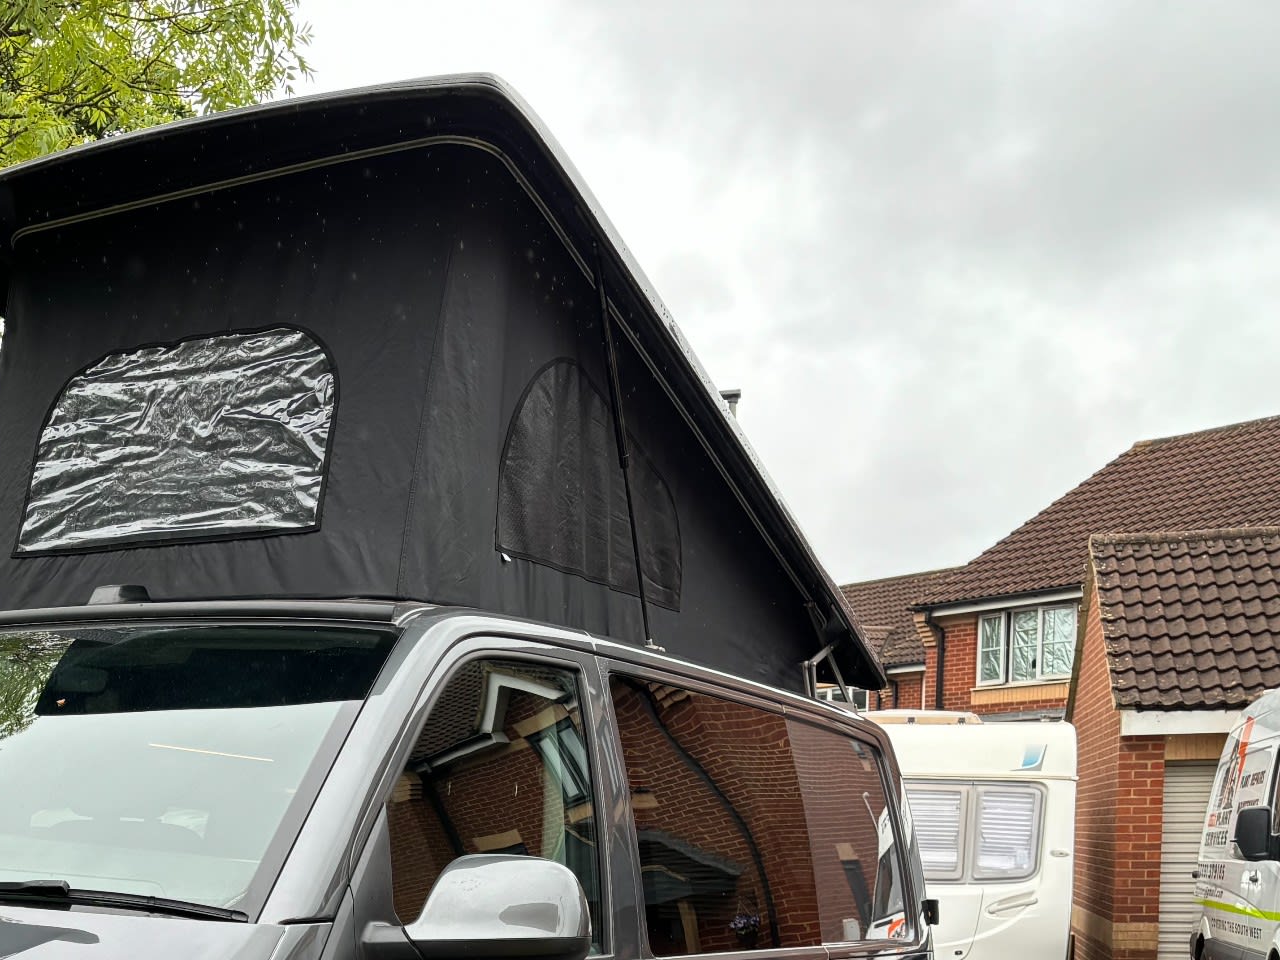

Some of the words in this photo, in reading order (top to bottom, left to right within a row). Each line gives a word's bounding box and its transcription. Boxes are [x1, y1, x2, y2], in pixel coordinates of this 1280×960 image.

[1205, 830, 1228, 847] SERVICES
[1227, 921, 1235, 933] THE
[1235, 923, 1249, 937] SOUTH
[1250, 927, 1262, 939] WEST
